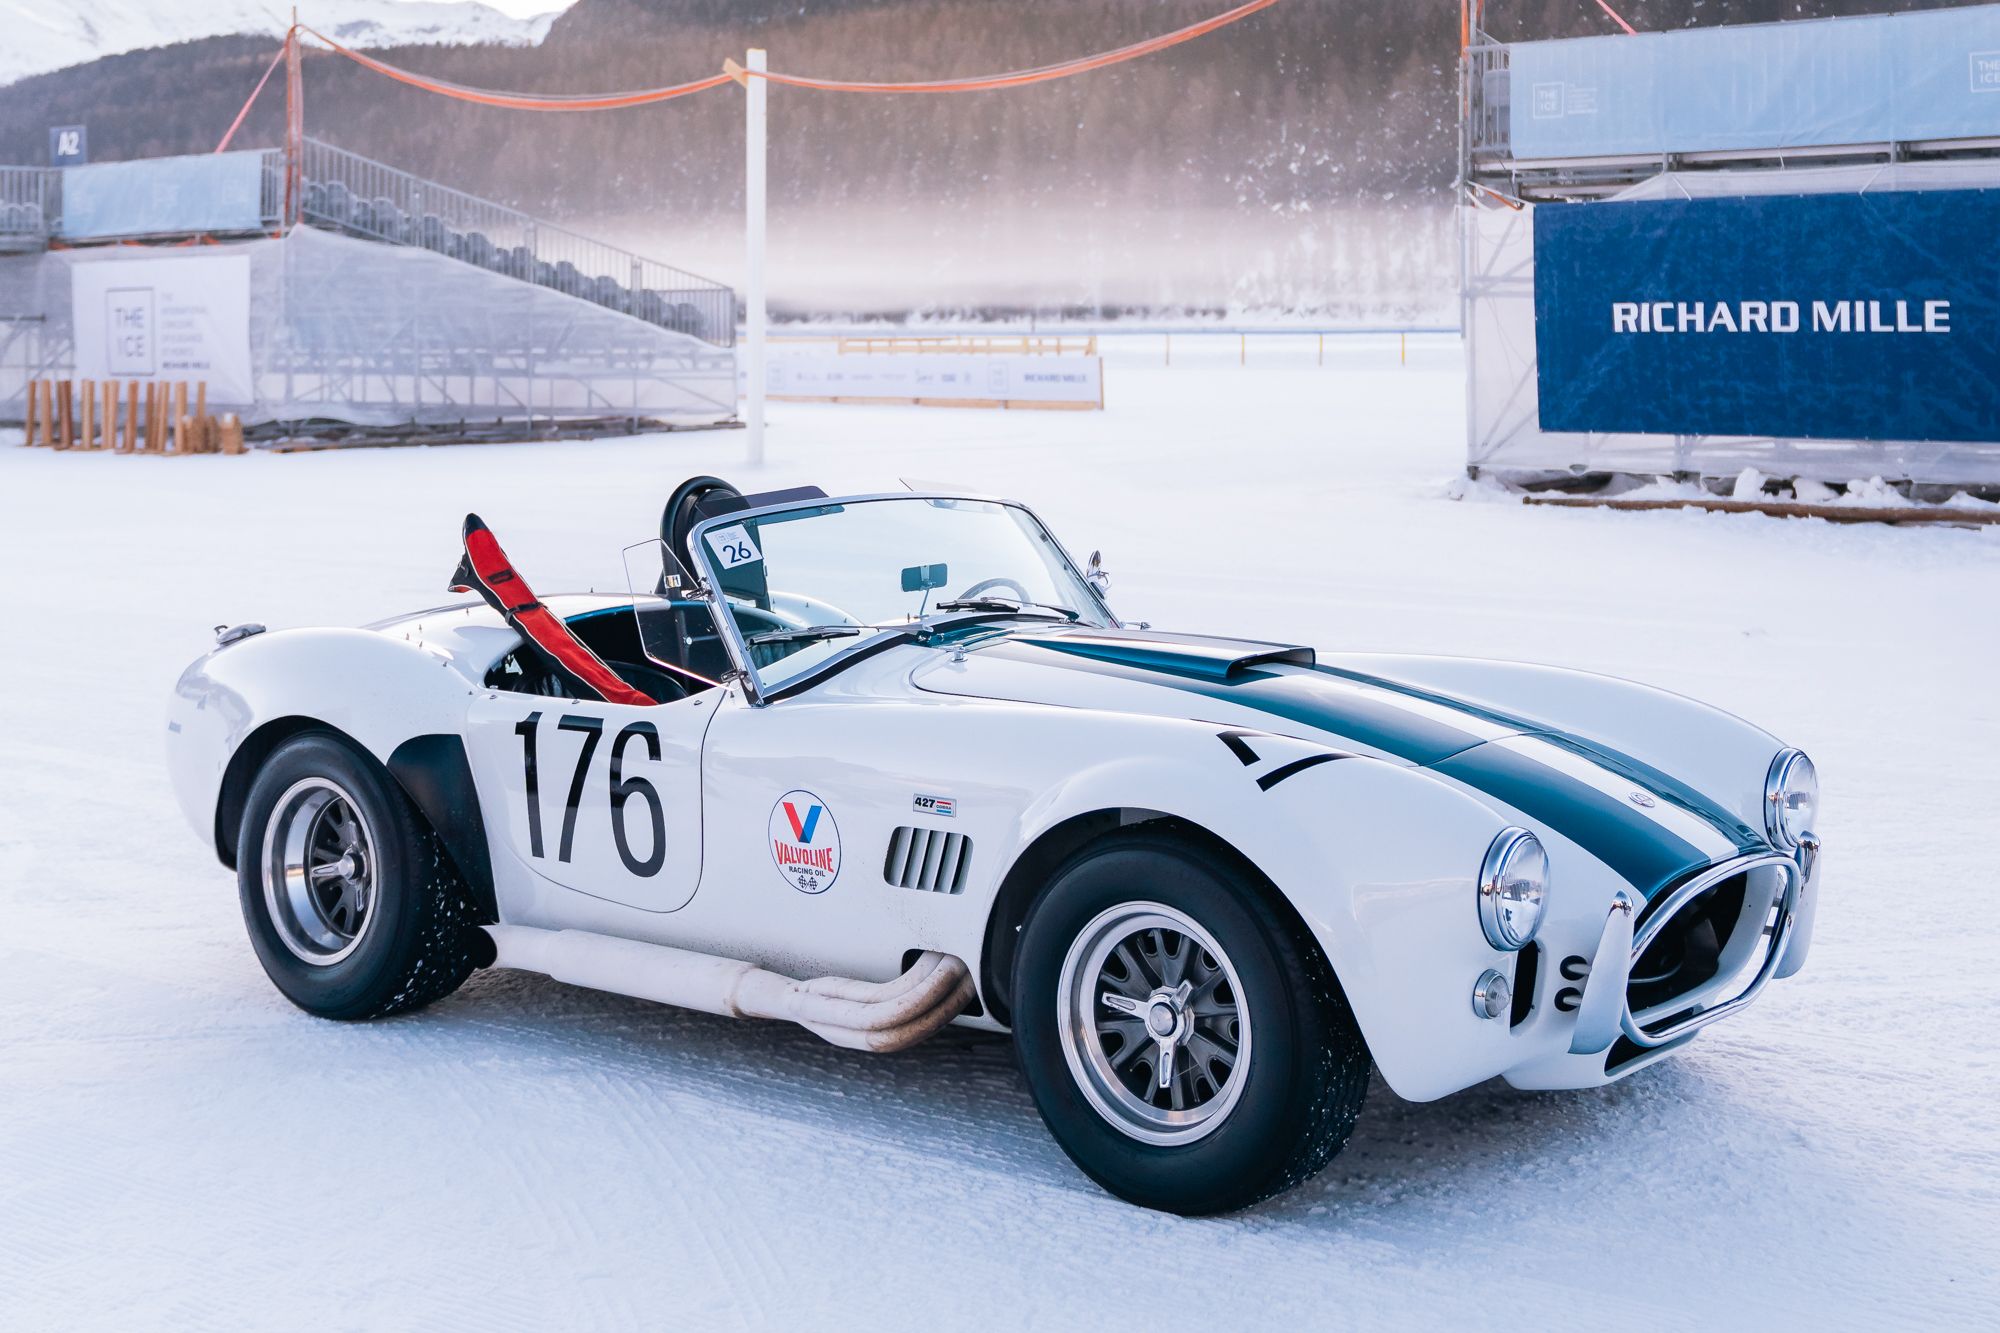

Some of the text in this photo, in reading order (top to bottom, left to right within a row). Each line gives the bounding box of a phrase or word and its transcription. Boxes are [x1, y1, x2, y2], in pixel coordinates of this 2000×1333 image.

[114, 306, 145, 330] THE
[1612, 300, 1951, 333] RICHARD MILLE
[117, 335, 146, 358] ICE
[723, 541, 752, 563] 26
[515, 711, 666, 877] 176
[915, 797, 936, 808] 427
[774, 838, 835, 873] VALVOLINE
[788, 865, 826, 878] RACING OIL
